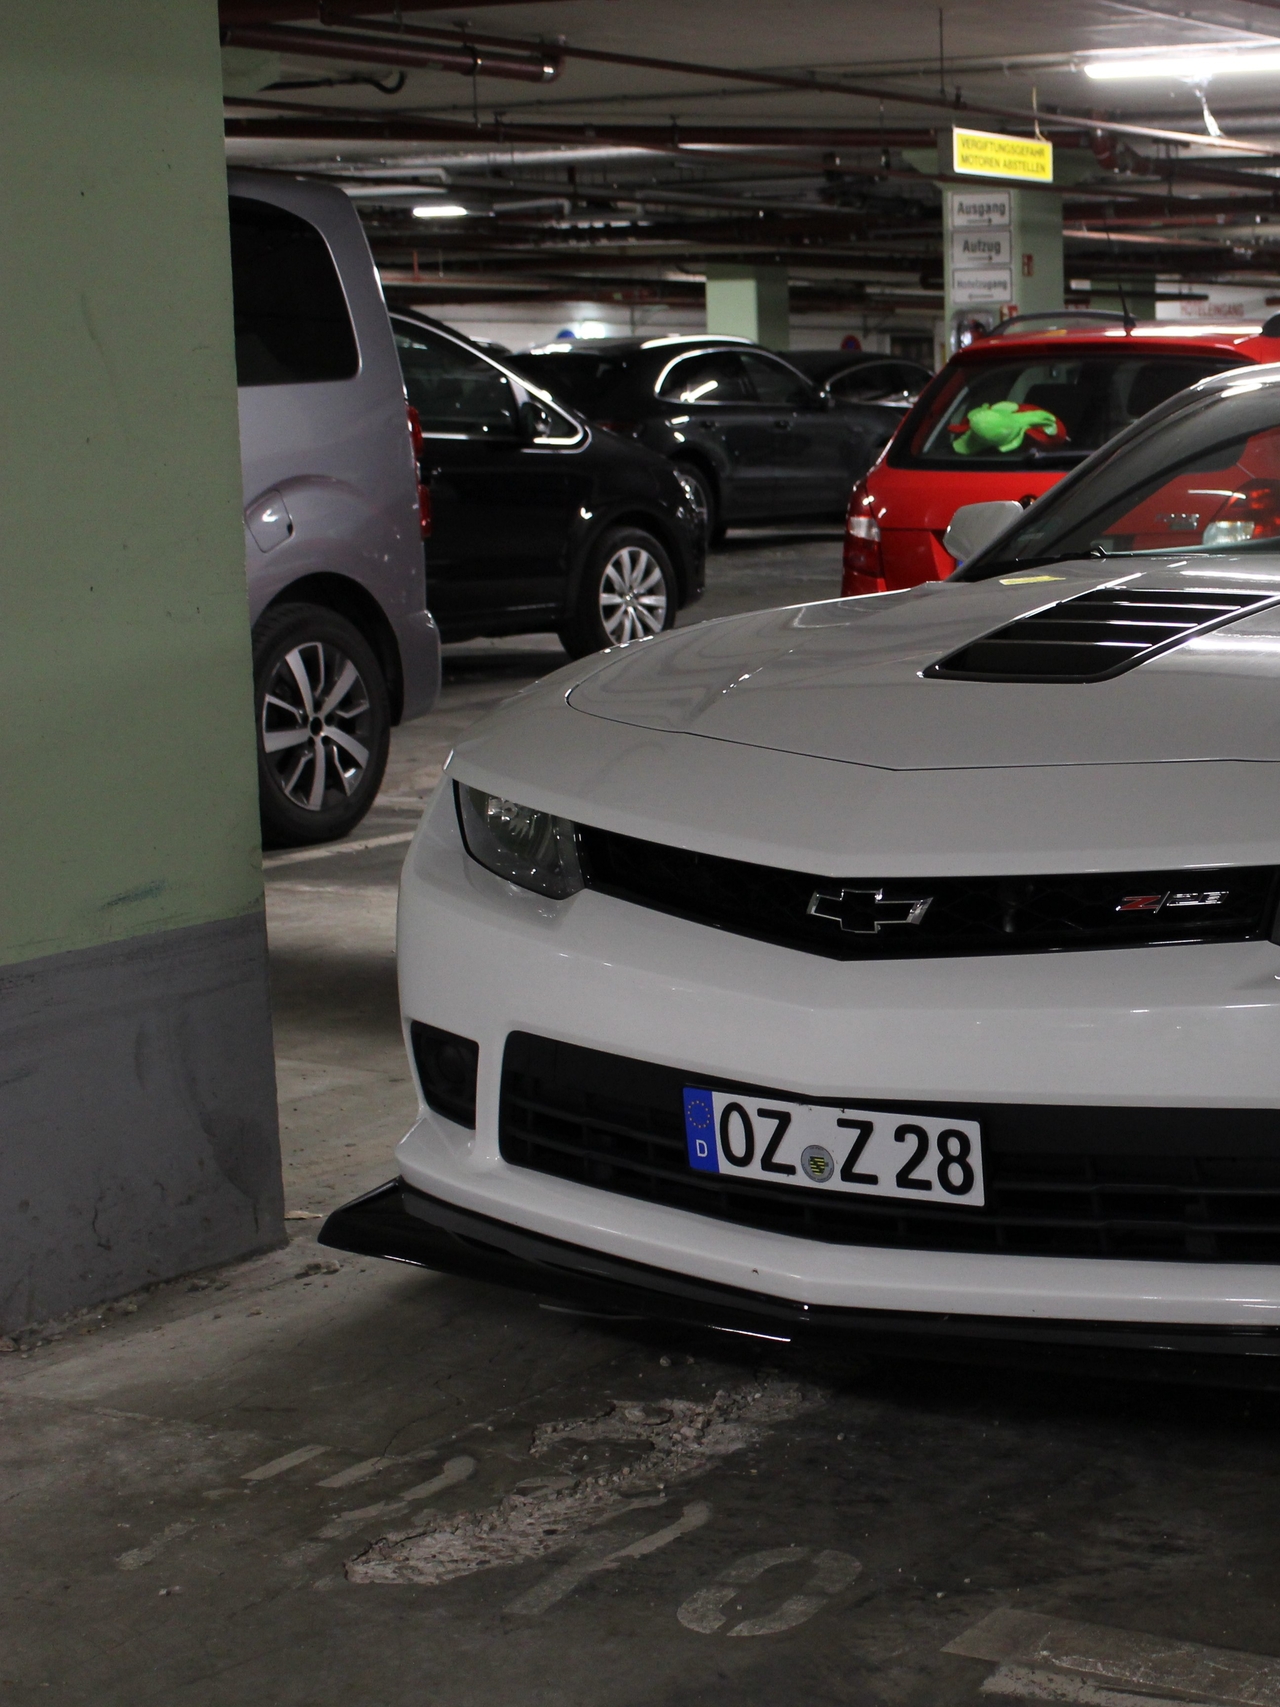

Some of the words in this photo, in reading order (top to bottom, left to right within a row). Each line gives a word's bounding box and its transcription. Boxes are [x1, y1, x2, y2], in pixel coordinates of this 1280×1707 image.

[961, 137, 1045, 157] VERGIFTUNGSGEFAHR
[961, 154, 1000, 168] MOTOREN
[1002, 158, 1046, 173] ABSTELLEN
[957, 202, 1006, 217] Ausgang
[962, 239, 1001, 254] Aufzug
[695, 1139, 709, 1158] D
[719, 1101, 797, 1176] OZ
[836, 1117, 879, 1186] Z
[893, 1123, 975, 1196] 28
